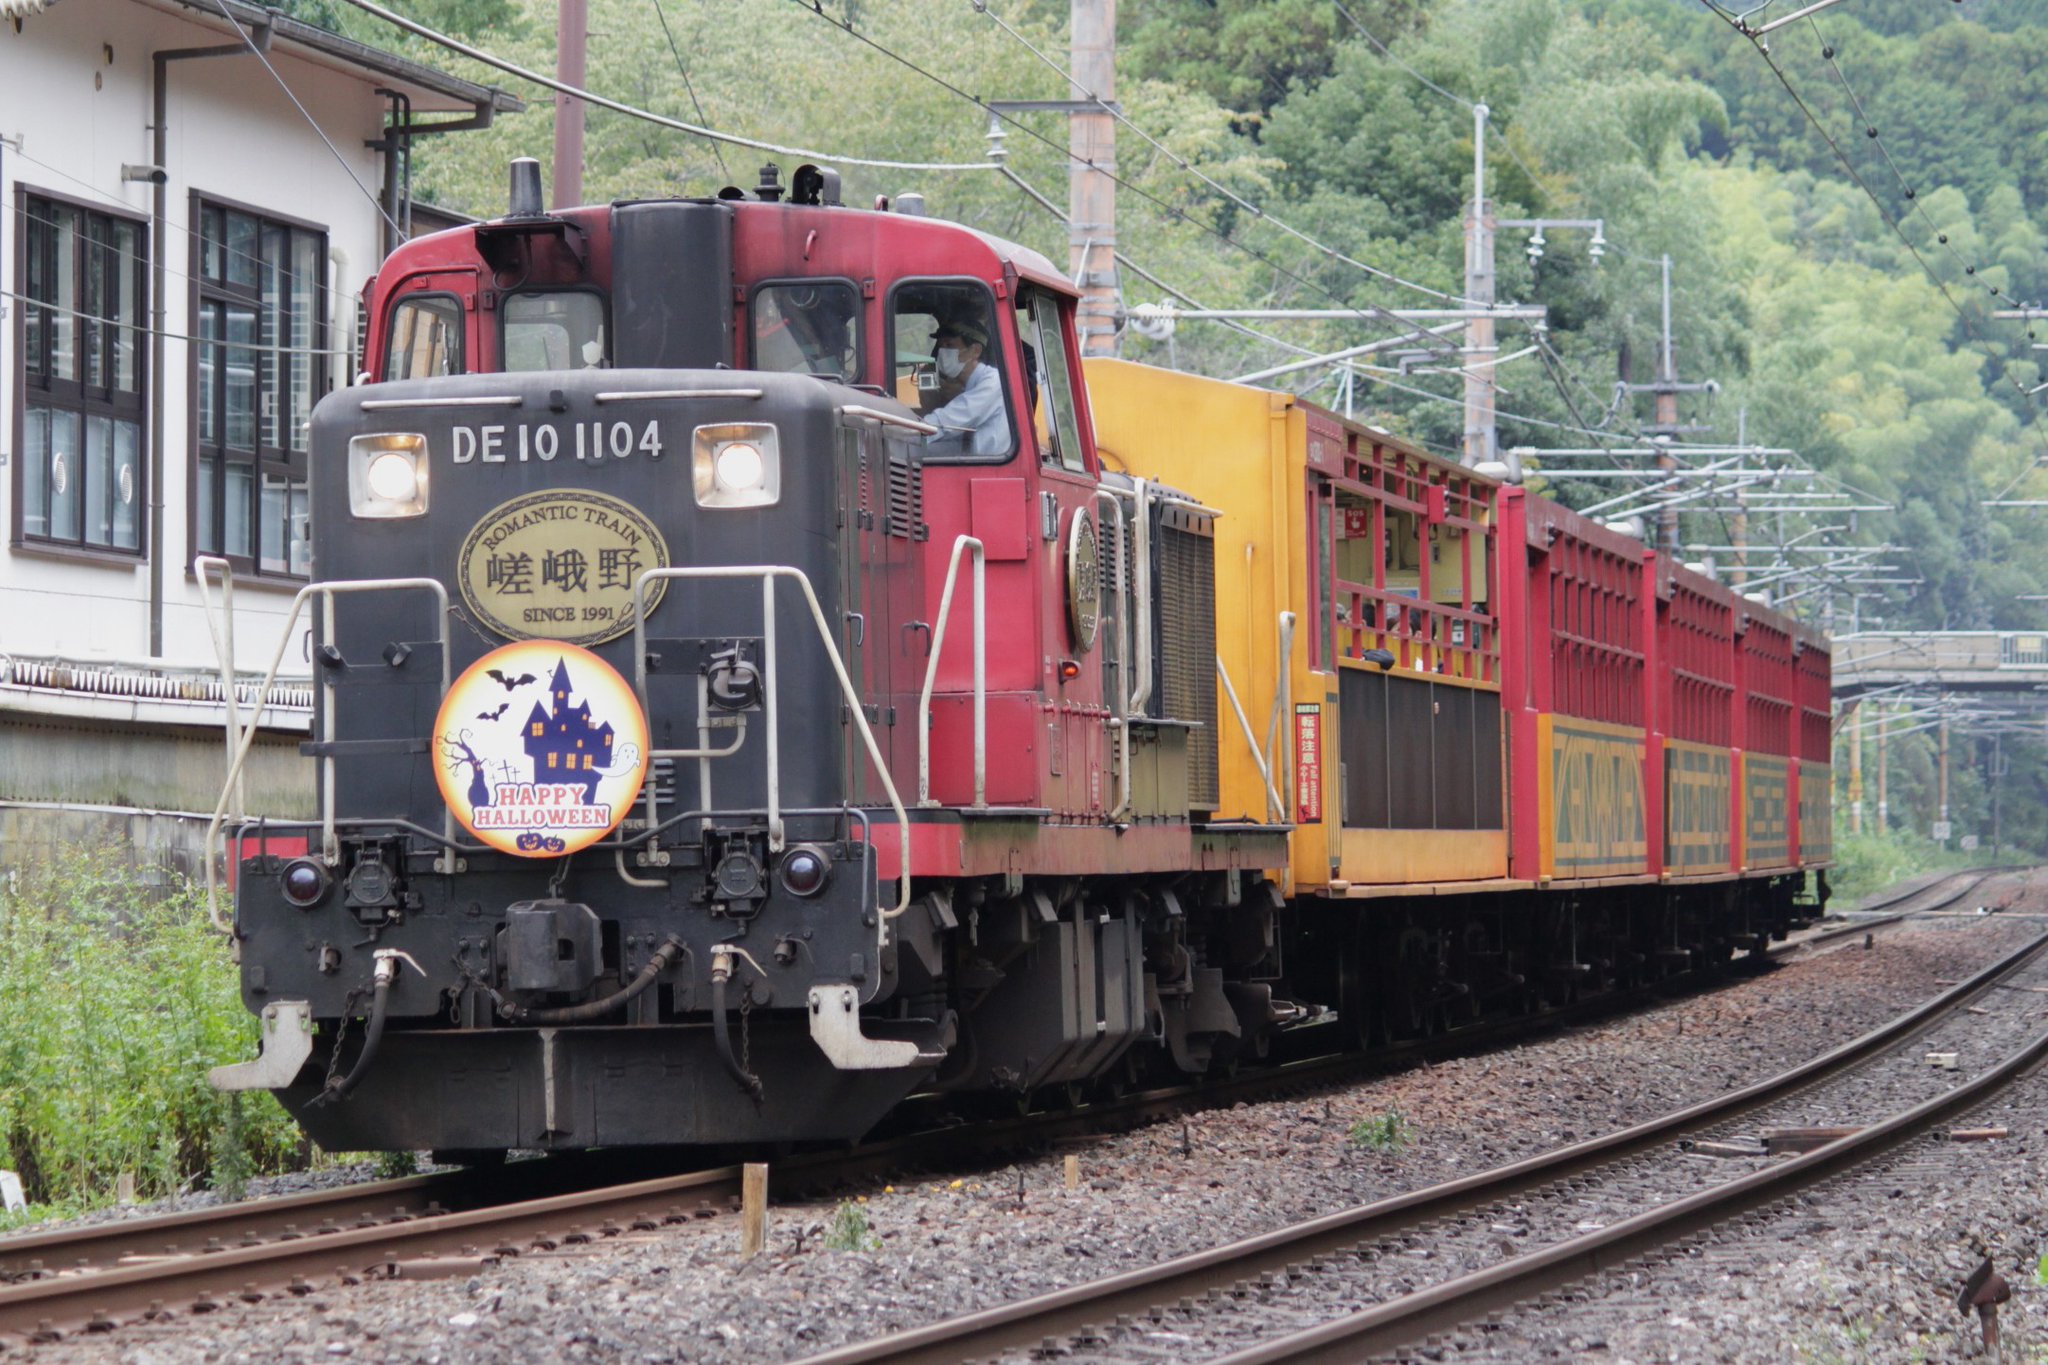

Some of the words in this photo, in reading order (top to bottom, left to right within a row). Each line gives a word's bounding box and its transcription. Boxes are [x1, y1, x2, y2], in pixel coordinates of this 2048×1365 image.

[576, 420, 663, 459] 1104
[482, 505, 578, 551] ROMANTIC
[583, 507, 642, 546] TRAIN
[486, 548, 643, 595] 嵯峨野
[523, 607, 576, 623] SINCE
[581, 606, 615, 621] 1991
[499, 787, 586, 806] HAPPY
[476, 808, 608, 826] HALLOWEEN
